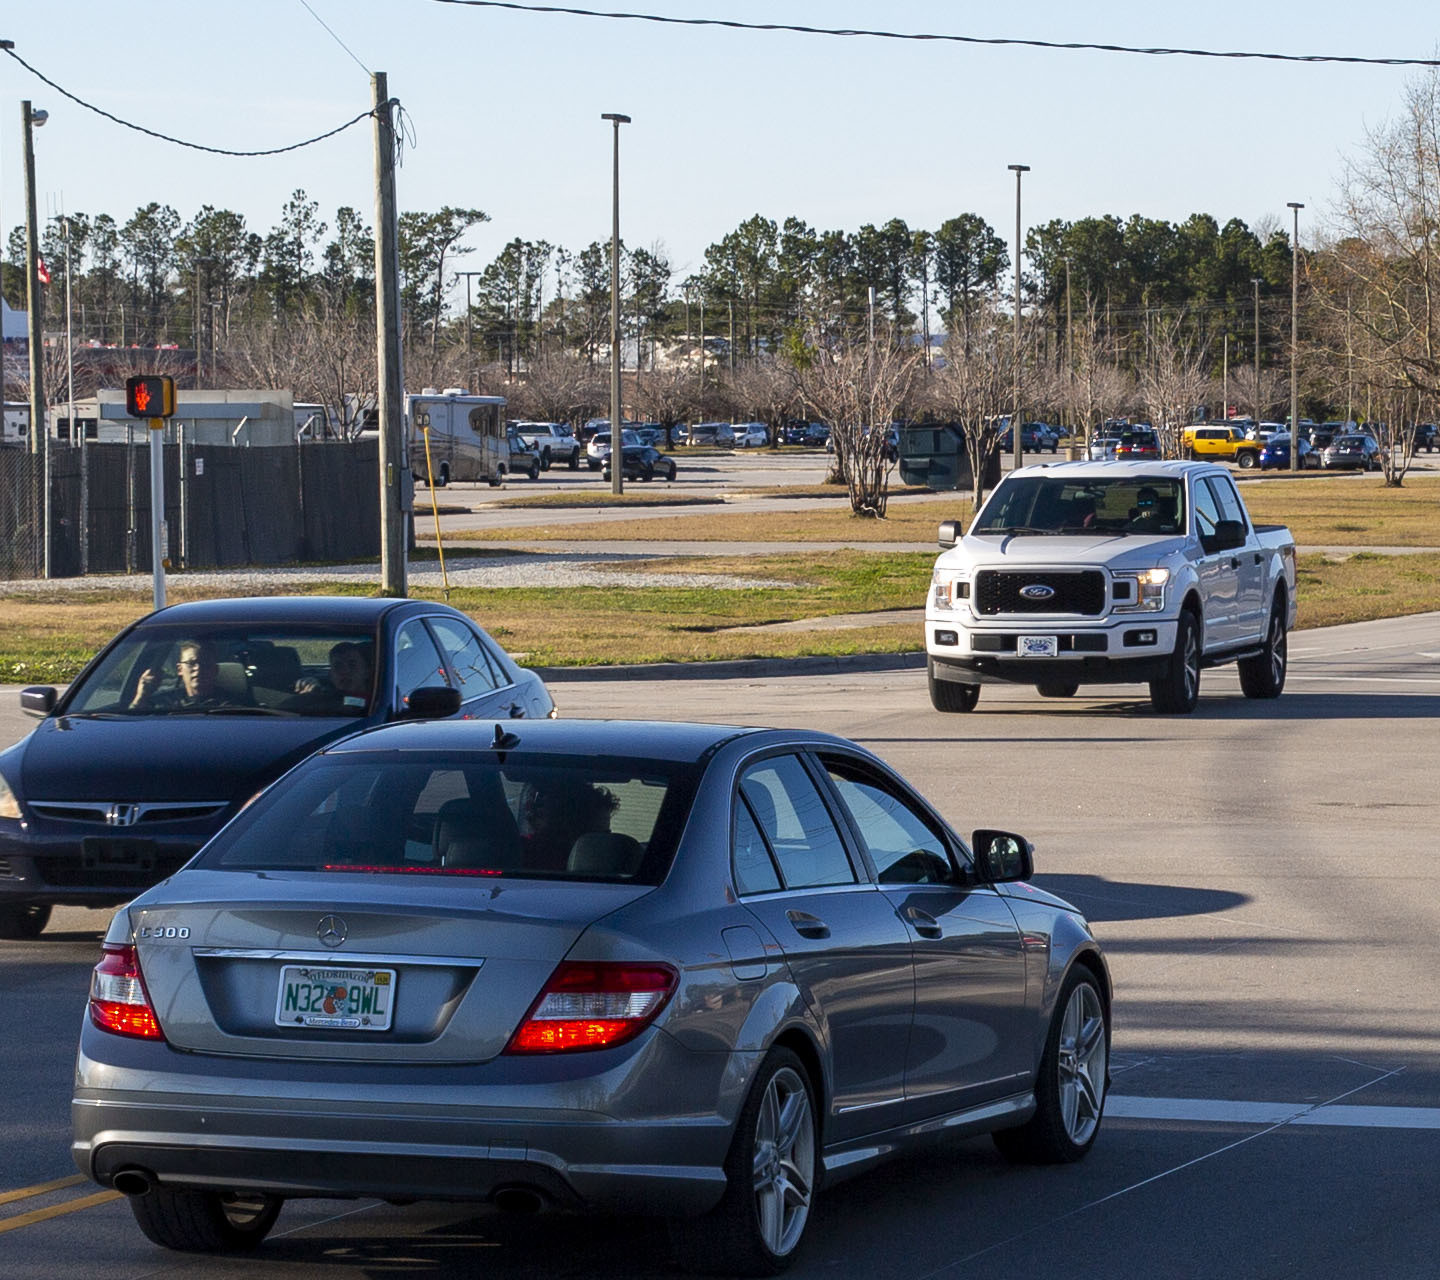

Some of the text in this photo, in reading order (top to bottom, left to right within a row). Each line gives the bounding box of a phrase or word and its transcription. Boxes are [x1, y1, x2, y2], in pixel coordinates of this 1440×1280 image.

[153, 927, 191, 939] 300
[284, 983, 385, 1015] N32 9WL
